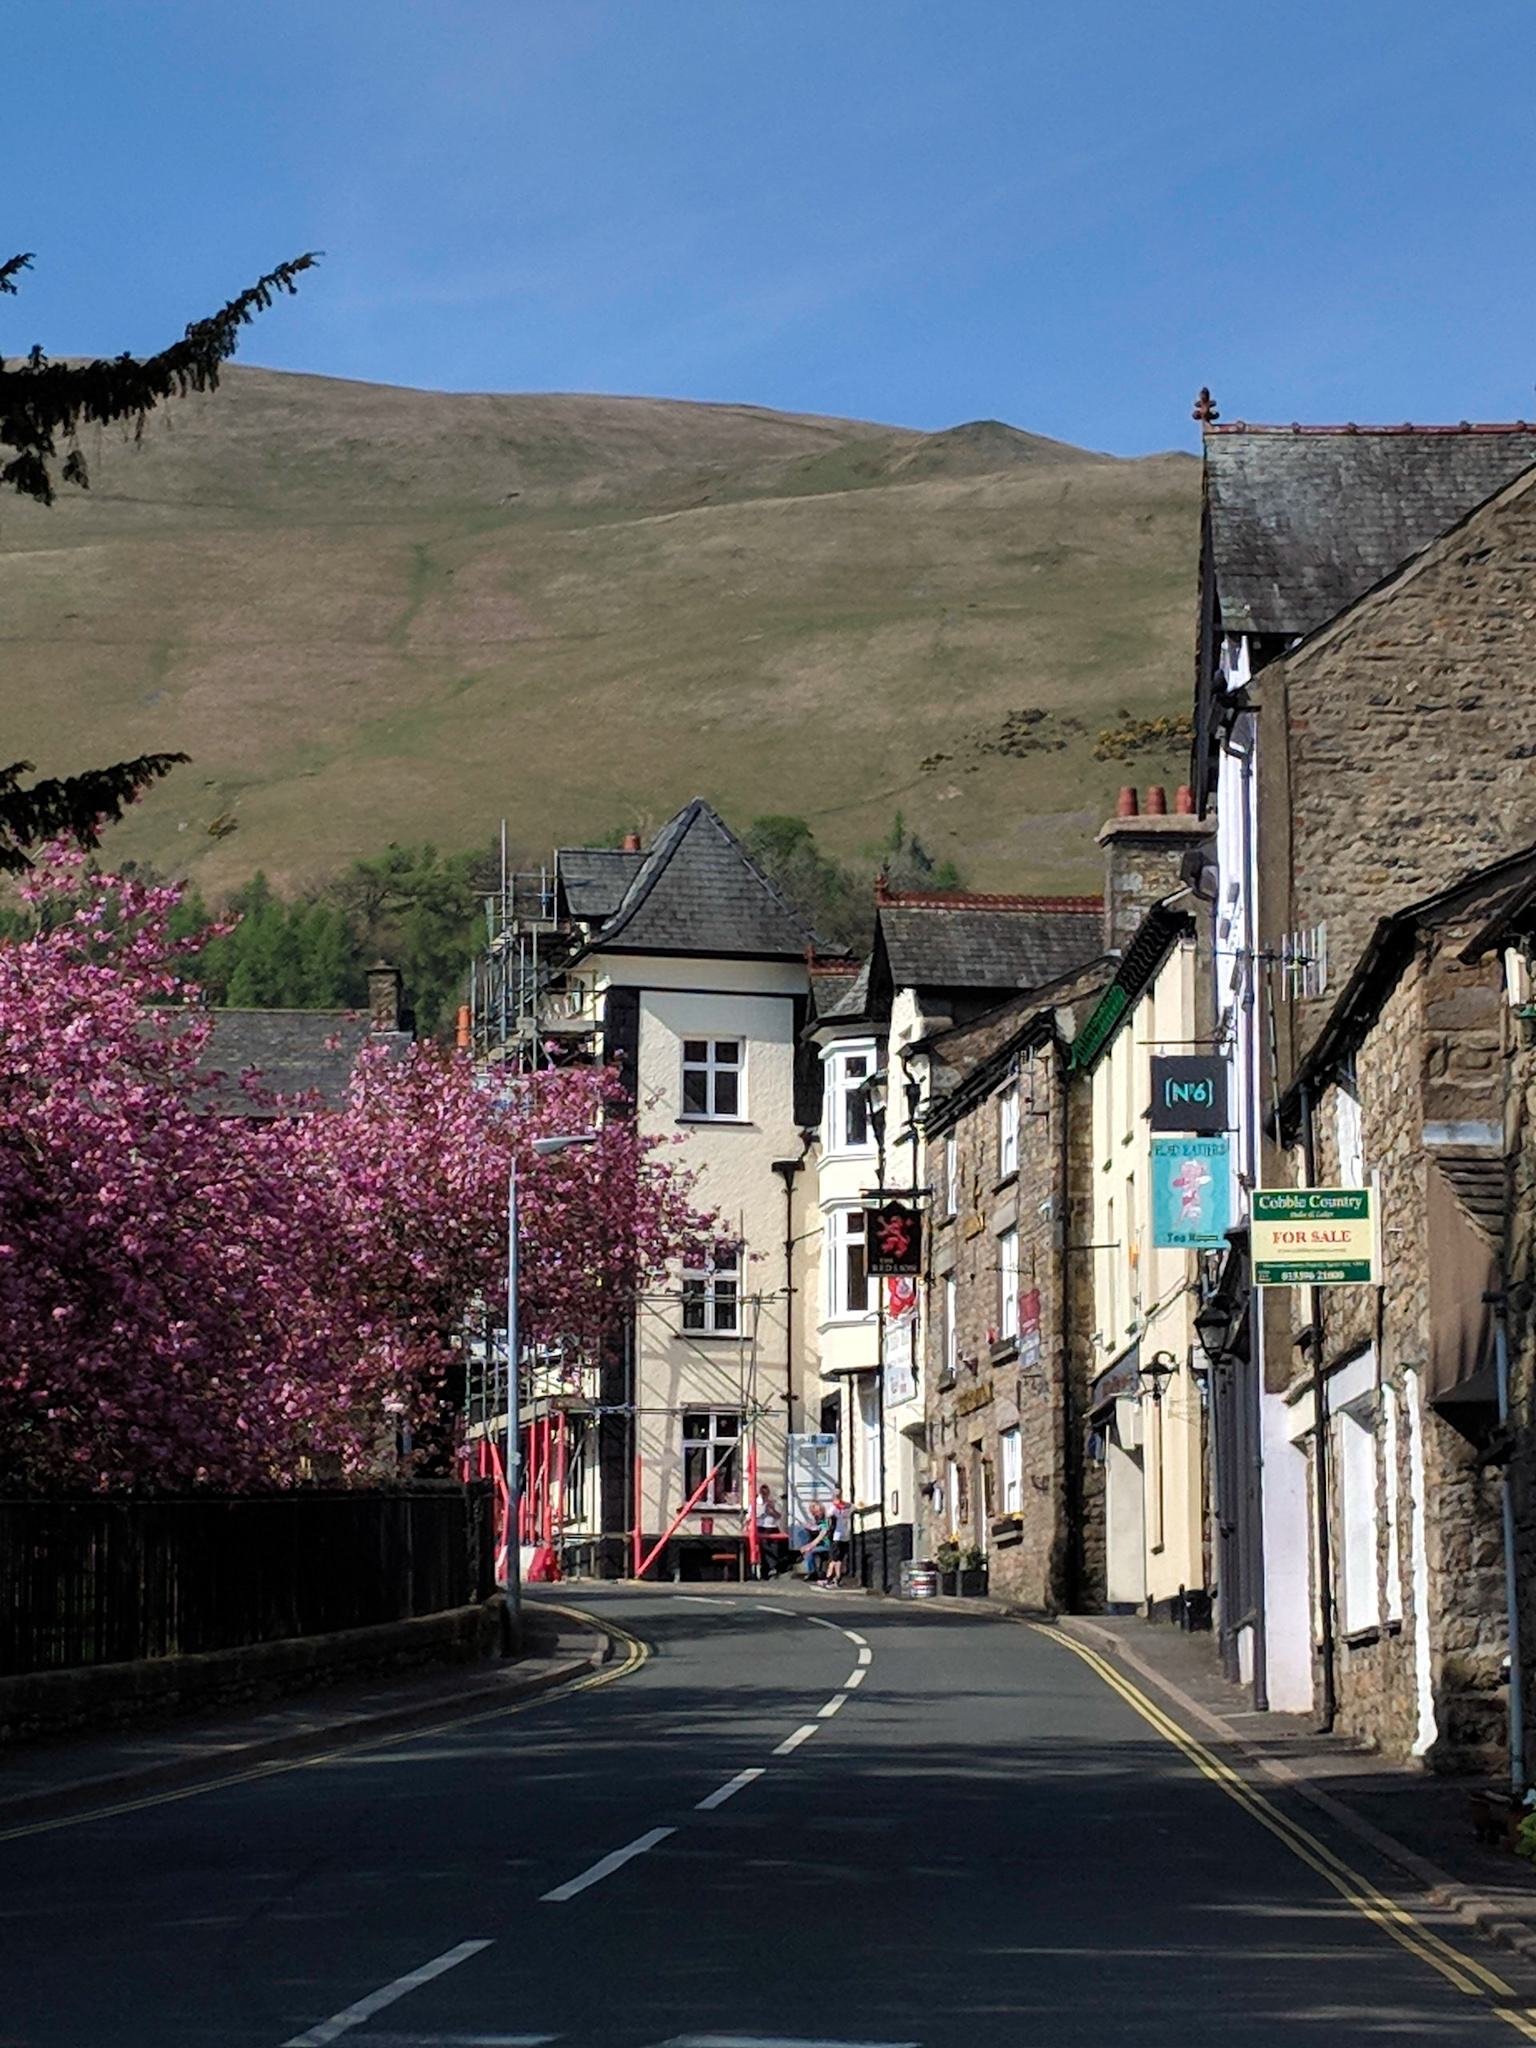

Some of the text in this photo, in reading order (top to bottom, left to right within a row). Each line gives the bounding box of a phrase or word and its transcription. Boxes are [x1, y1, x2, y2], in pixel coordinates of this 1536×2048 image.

[1309, 1195, 1362, 1210] Country
[1272, 1230, 1352, 1244] FOR SALE
